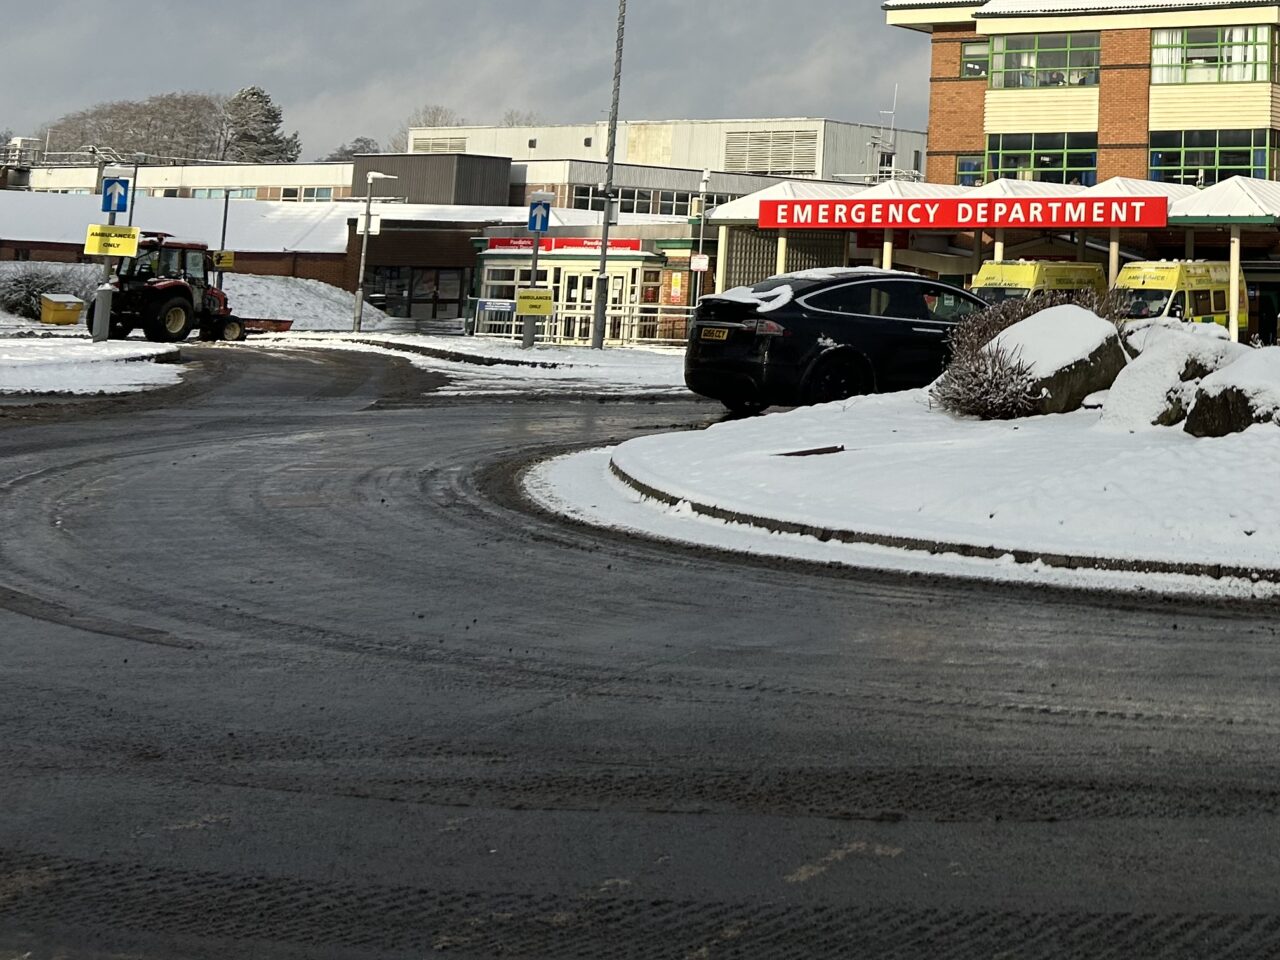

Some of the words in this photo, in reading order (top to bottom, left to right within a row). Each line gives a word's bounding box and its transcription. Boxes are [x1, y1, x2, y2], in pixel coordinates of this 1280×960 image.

[776, 203, 940, 224] EMERGENCY
[956, 201, 1146, 223] DEPARTMENT
[90, 231, 136, 239] AMBULANCES
